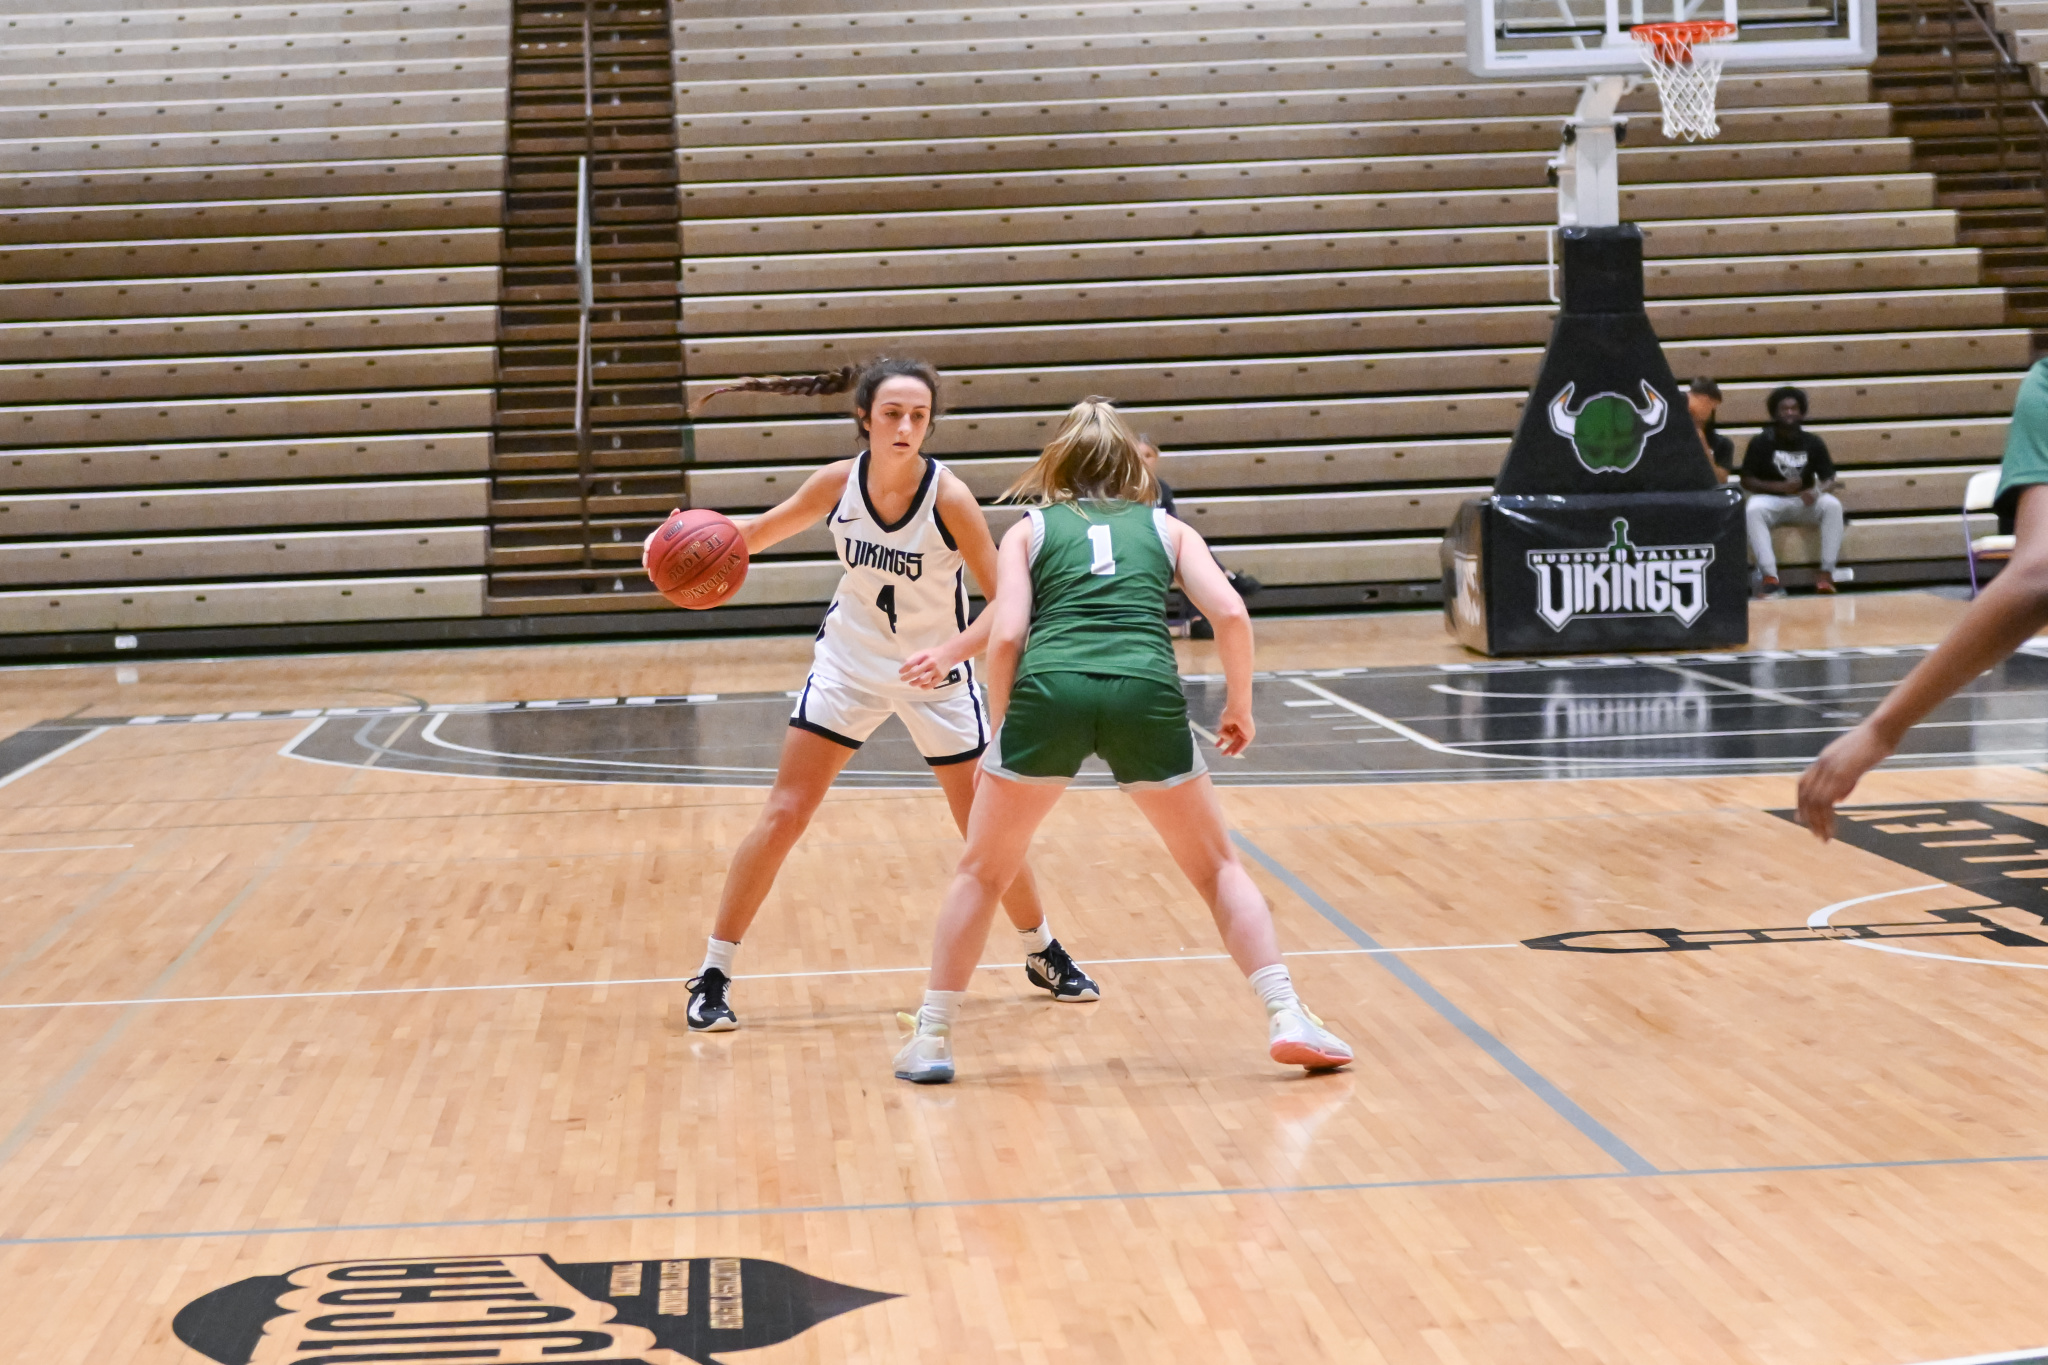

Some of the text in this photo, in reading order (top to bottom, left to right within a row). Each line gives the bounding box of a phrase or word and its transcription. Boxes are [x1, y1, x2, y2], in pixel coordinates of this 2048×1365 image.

[680, 549, 741, 600] SPALDING
[844, 537, 926, 582] VIKINGS
[1087, 525, 1116, 575] 1
[1532, 549, 1709, 564] HUDSON VALLEY
[876, 585, 898, 634] 4
[1536, 559, 1708, 628] VIKINGS
